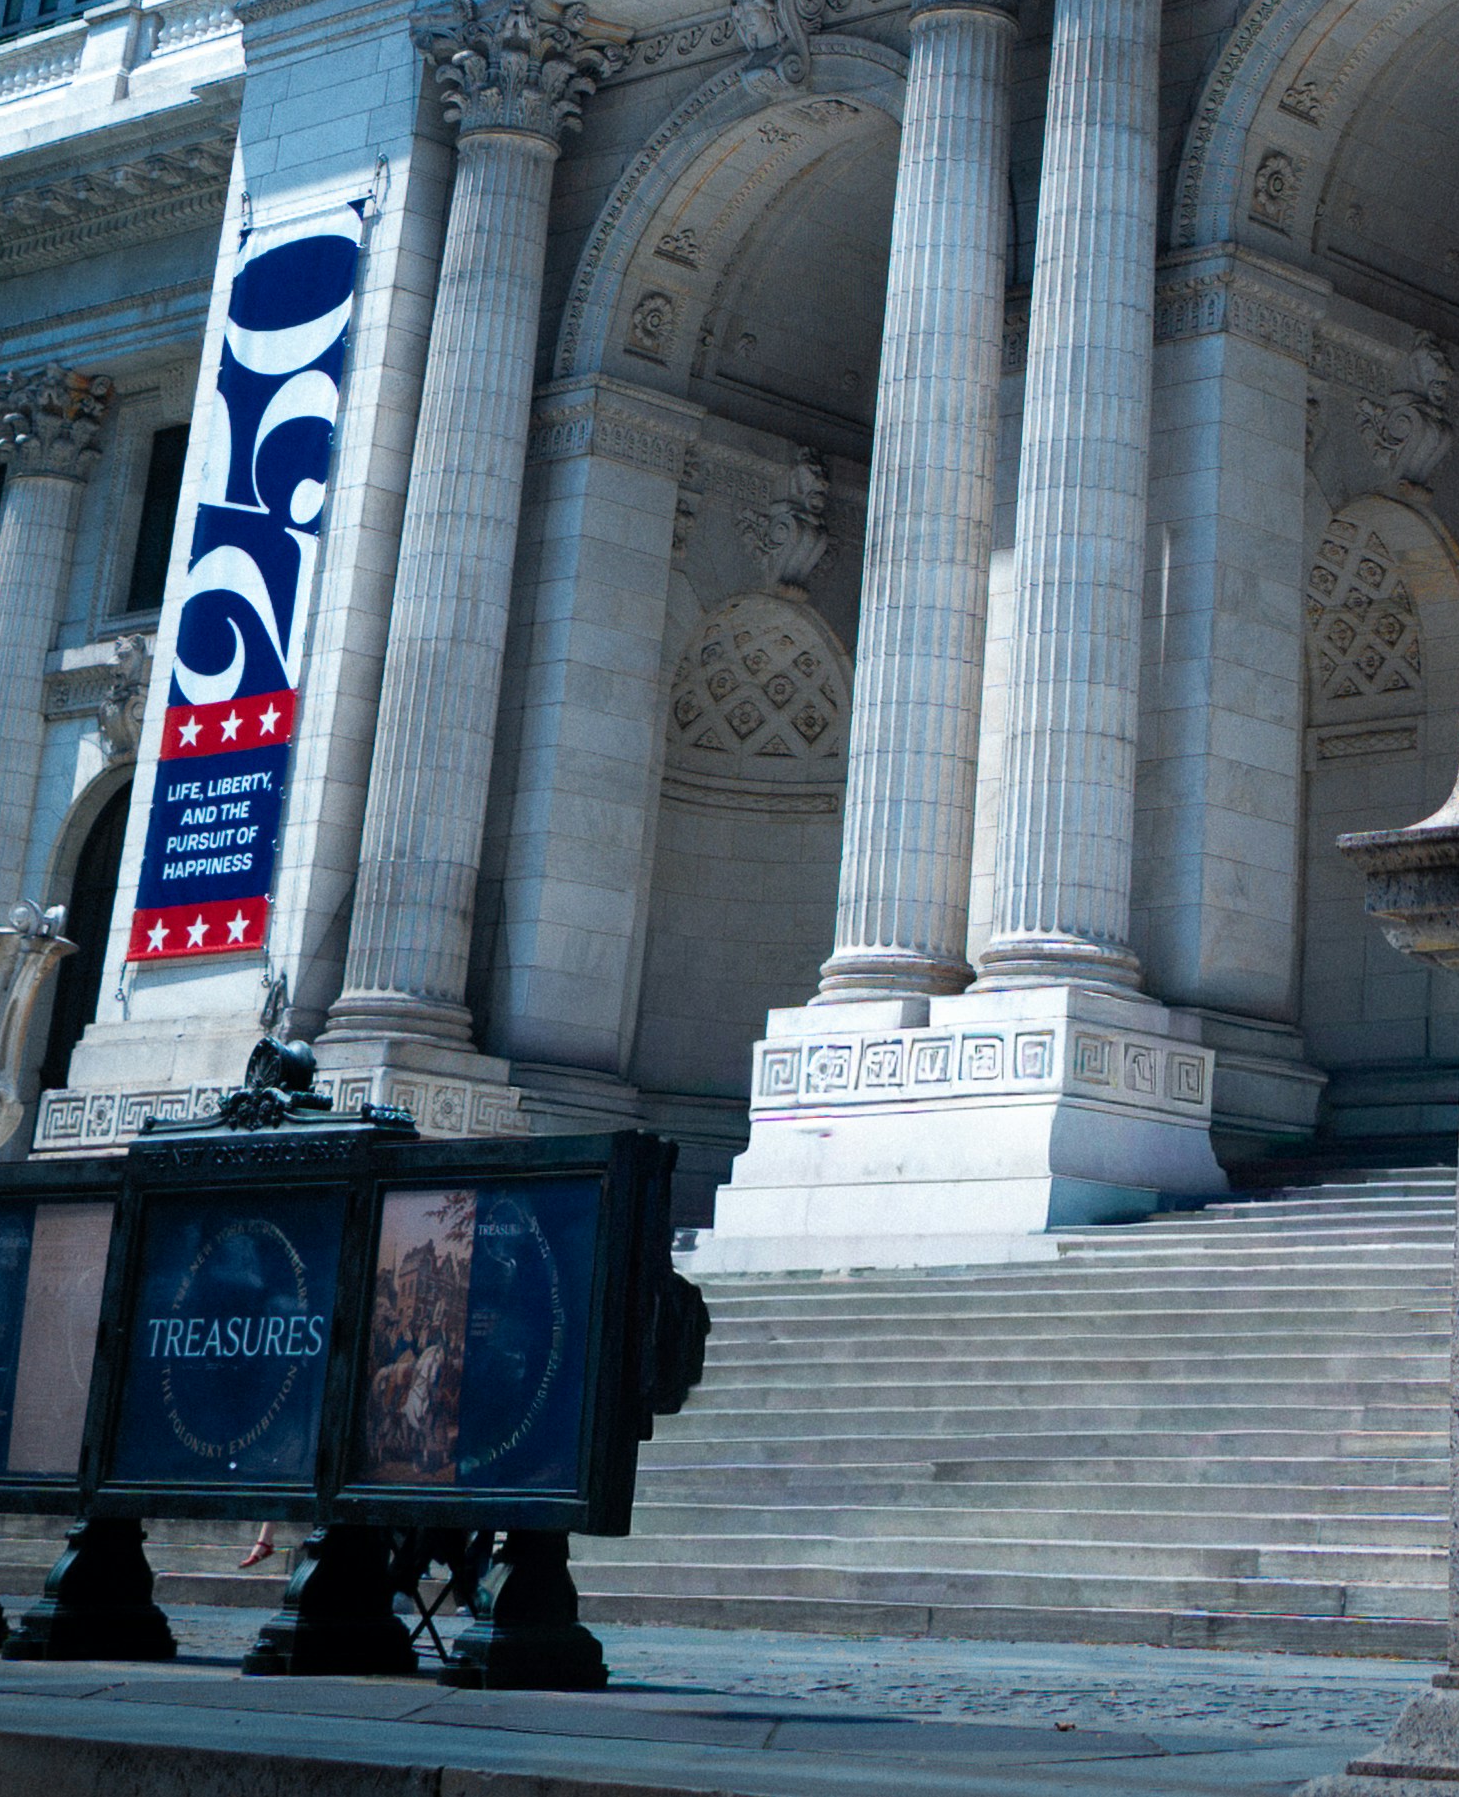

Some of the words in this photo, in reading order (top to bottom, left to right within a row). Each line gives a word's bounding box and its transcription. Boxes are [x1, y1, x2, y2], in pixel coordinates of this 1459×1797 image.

[167, 782, 204, 802] LIFE,
[207, 771, 272, 797] LIBERTY,
[180, 805, 218, 826] AND
[221, 800, 251, 820] THE
[166, 829, 235, 854] PURSUIT
[236, 825, 259, 844] OF
[162, 852, 253, 880] HAPPINESS
[148, 1315, 324, 1357] TREASURES
[168, 1409, 223, 1458] POLONSKY
[229, 1364, 298, 1456] EXHIBITION
